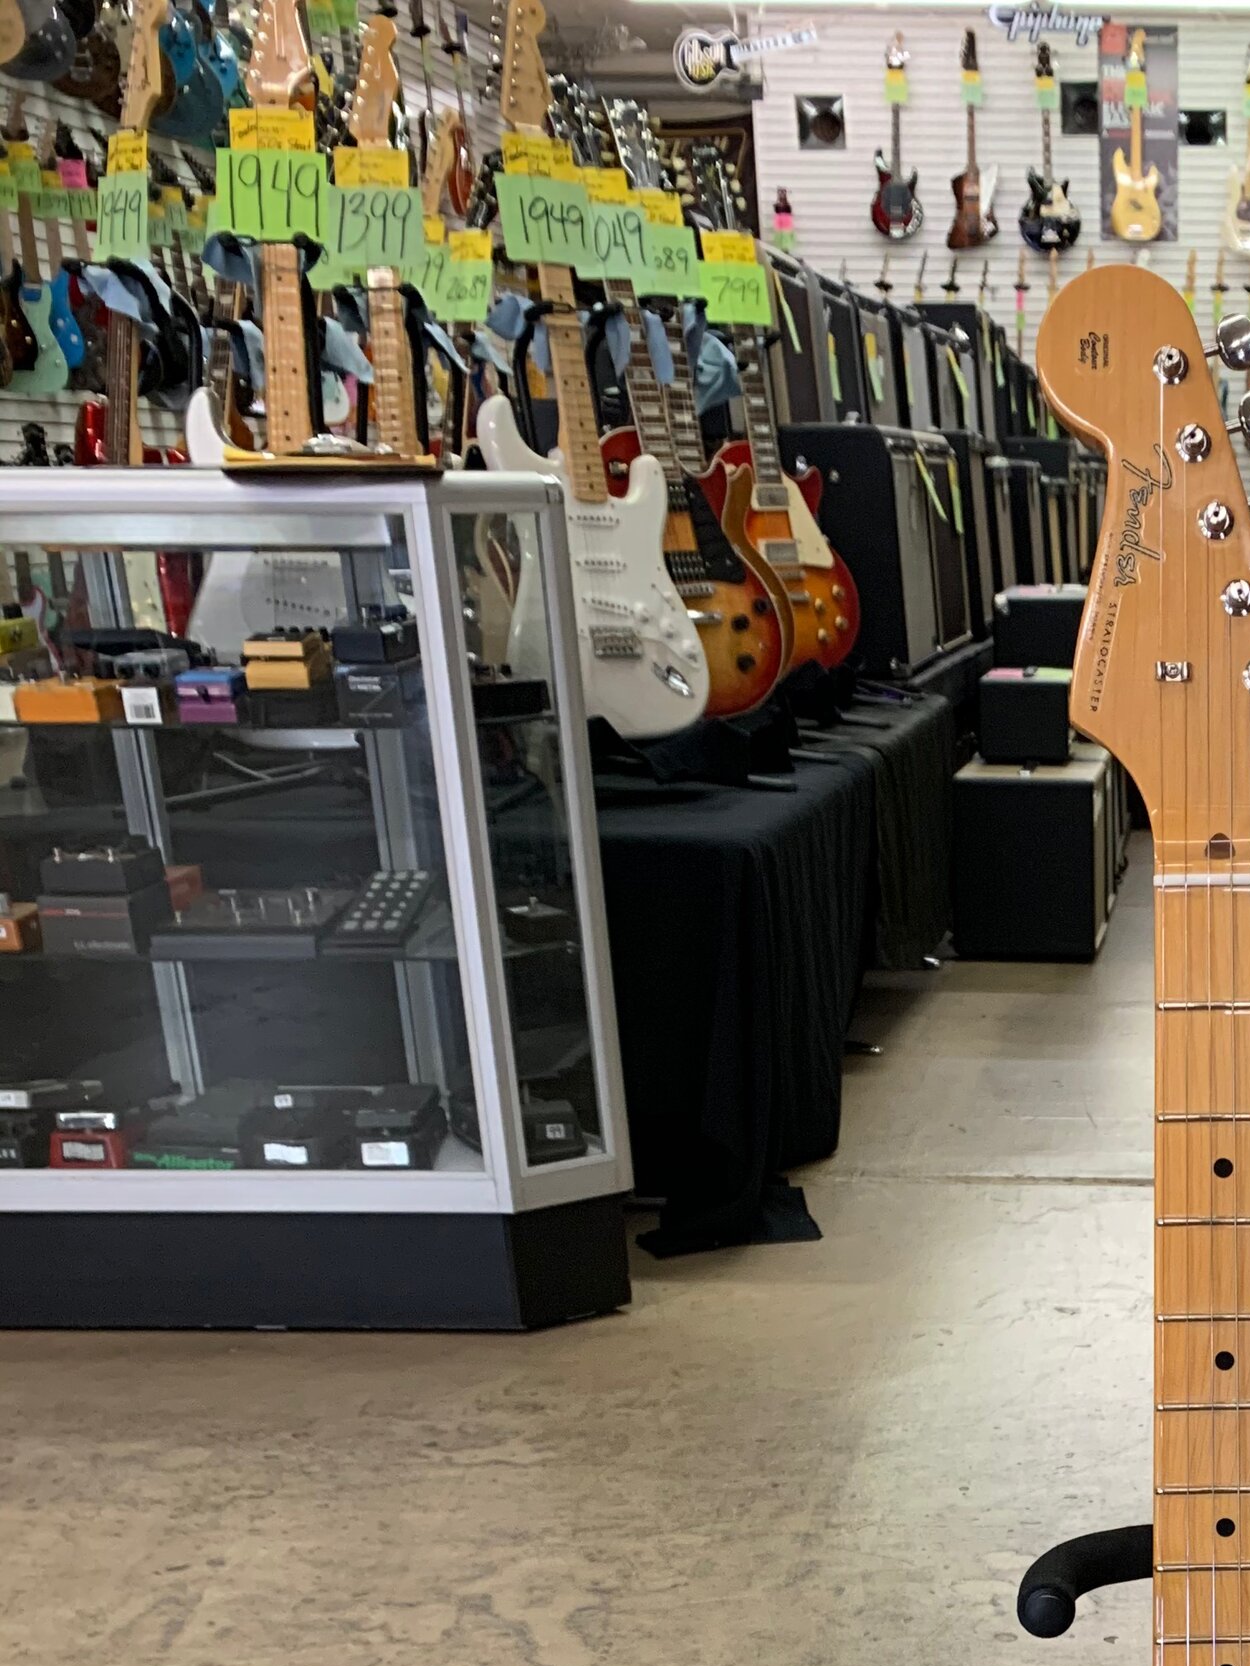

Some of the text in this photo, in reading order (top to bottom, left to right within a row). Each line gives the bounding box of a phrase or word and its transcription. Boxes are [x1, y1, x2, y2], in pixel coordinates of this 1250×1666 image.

[99, 187, 142, 246] 1949
[229, 153, 320, 238] 1949
[337, 191, 412, 259] 1399
[519, 195, 586, 250] 1949
[711, 275, 760, 305] 799
[1078, 338, 1091, 364] Body
[1113, 443, 1175, 588] Fender
[1089, 602, 1119, 713] STRATOCASTER
